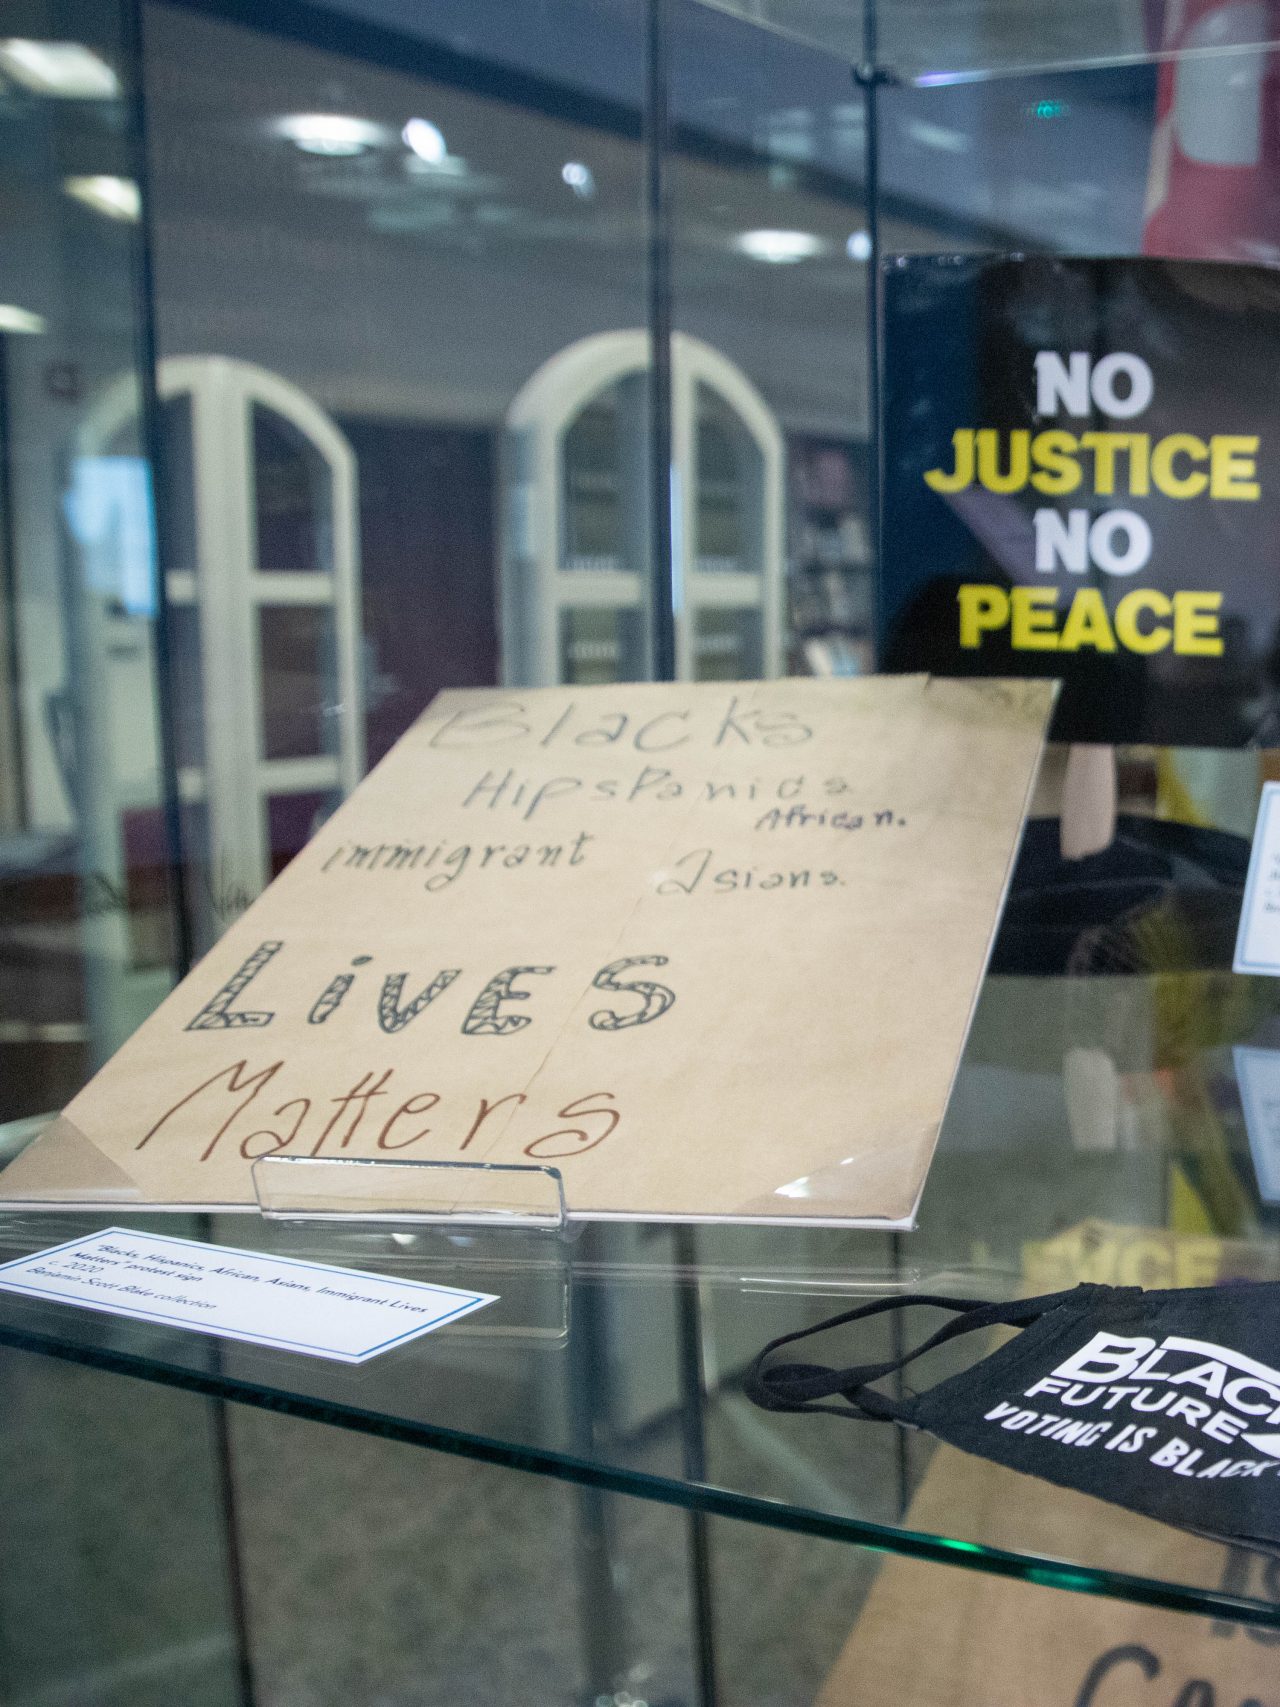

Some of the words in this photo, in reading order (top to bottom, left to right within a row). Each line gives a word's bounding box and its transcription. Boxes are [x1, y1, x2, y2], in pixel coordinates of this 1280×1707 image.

[1034, 351, 1154, 419] NO
[923, 429, 1261, 499] JUSTICE
[1034, 509, 1153, 575] NO
[957, 584, 1224, 656] PEACE
[429, 697, 813, 752] Blacks
[134, 1058, 621, 1162] Matters
[26, 1266, 82, 1284] Benjamin
[81, 1277, 119, 1291] Scott
[117, 1284, 155, 1299] Blake
[154, 1292, 217, 1310] collection
[62, 1260, 105, 1274] 2020
[124, 1262, 177, 1278] protest
[174, 1271, 203, 1283] sign
[143, 1253, 206, 1272] Hispanics,
[210, 1265, 260, 1283] African,
[266, 1276, 310, 1293] Asians,
[316, 1286, 392, 1306] Immigrant
[388, 1299, 429, 1314] Lives
[984, 1401, 1113, 1448] VOTING
[1104, 1423, 1158, 1453] IS
[1023, 1376, 1250, 1446] FUTURE
